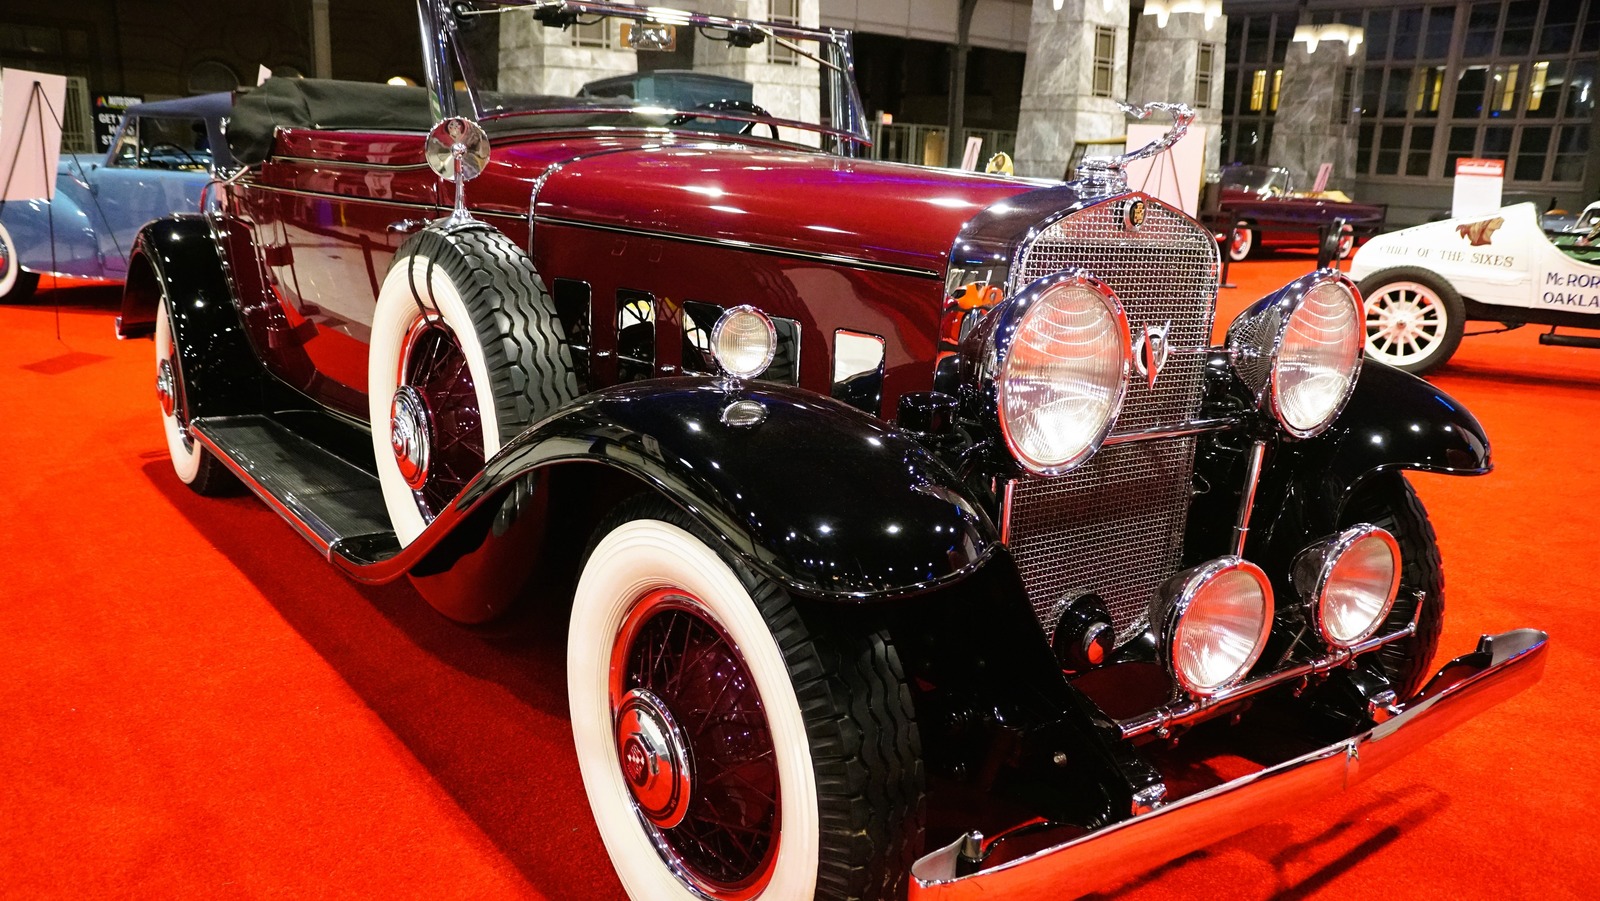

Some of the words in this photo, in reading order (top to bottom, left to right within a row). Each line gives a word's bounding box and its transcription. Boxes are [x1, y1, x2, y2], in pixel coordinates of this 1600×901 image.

[98, 113, 117, 124] GET
[1439, 250, 1464, 262] THE
[1471, 252, 1514, 268] SIXES
